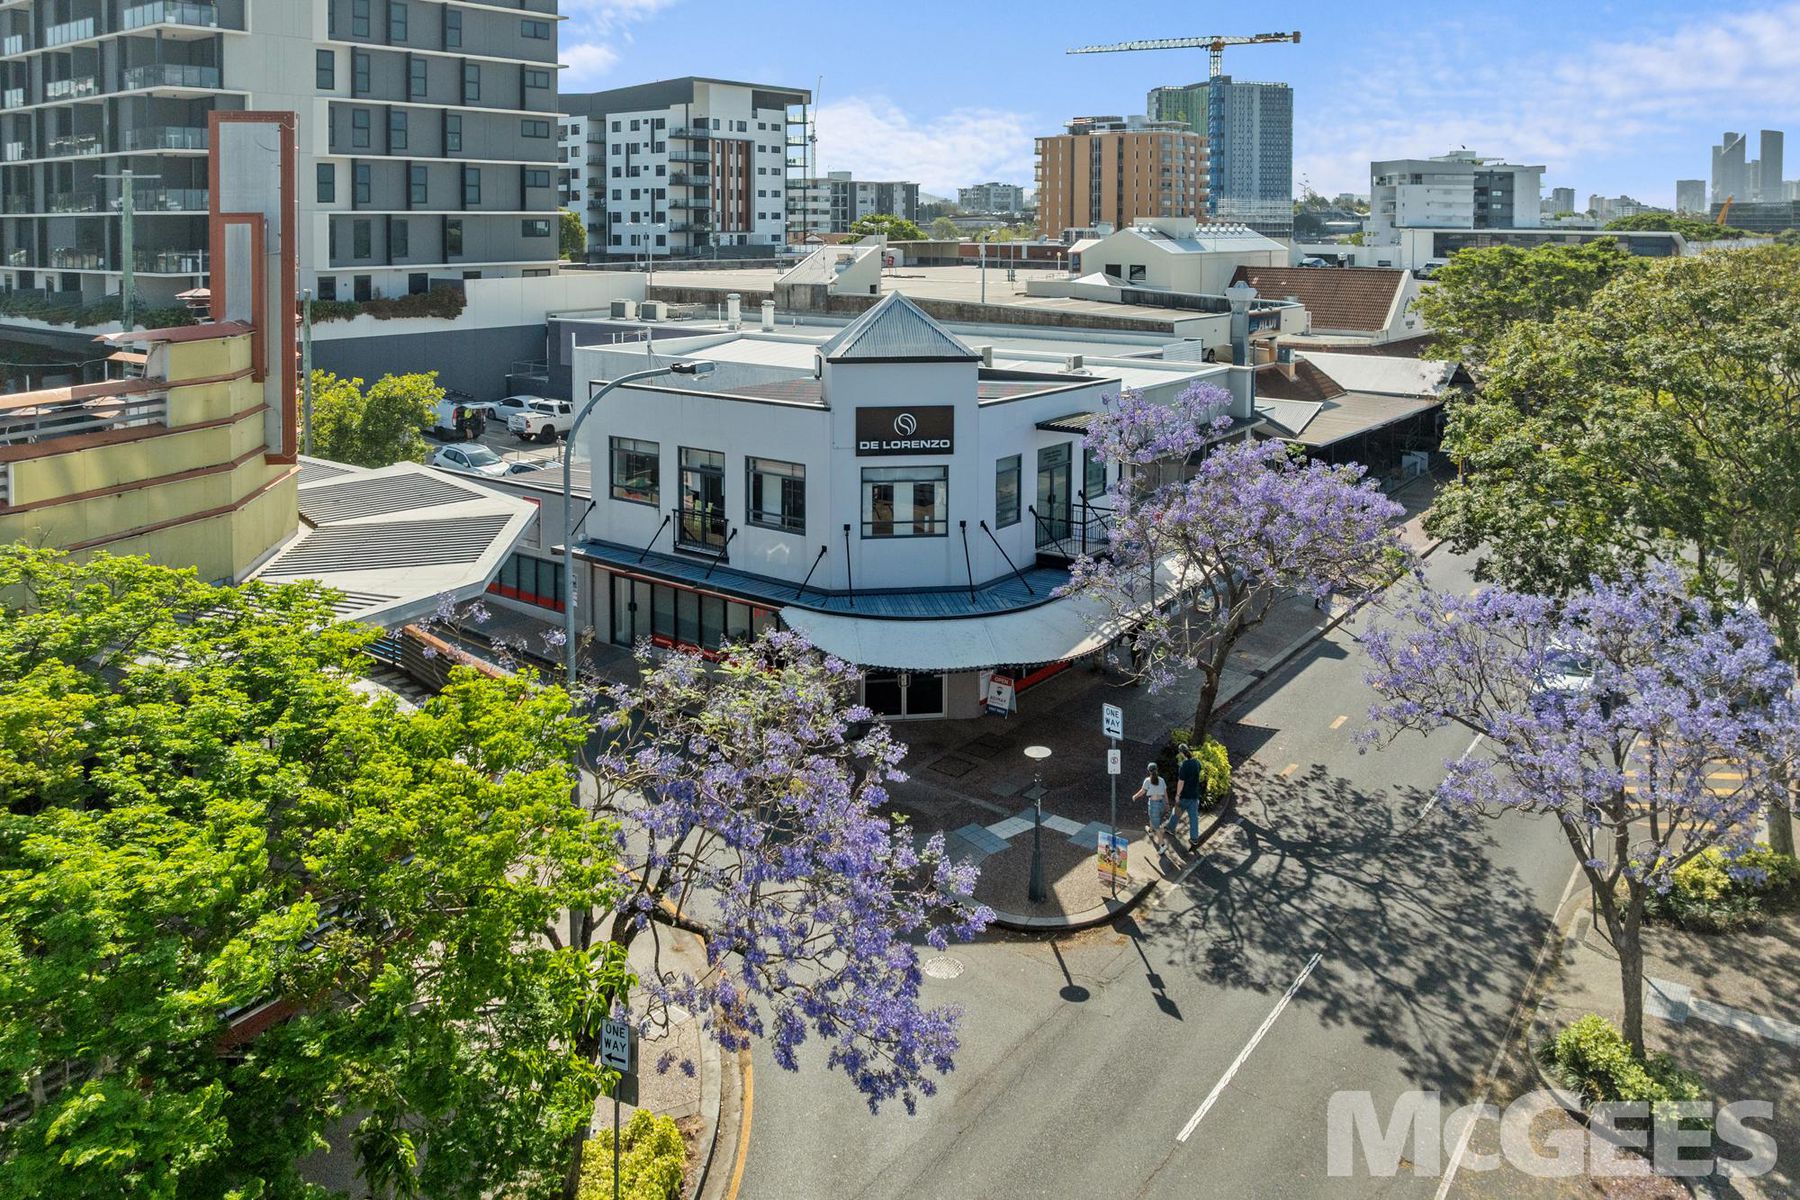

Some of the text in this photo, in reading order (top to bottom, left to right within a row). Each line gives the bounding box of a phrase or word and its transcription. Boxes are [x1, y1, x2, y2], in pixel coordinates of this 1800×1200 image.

[859, 439, 951, 450] DE LORENZO
[994, 676, 1009, 685] OPEN
[1105, 707, 1120, 719] ONE
[1105, 717, 1121, 728] WAY
[605, 1023, 626, 1039] ONE
[603, 1037, 627, 1053] WAY
